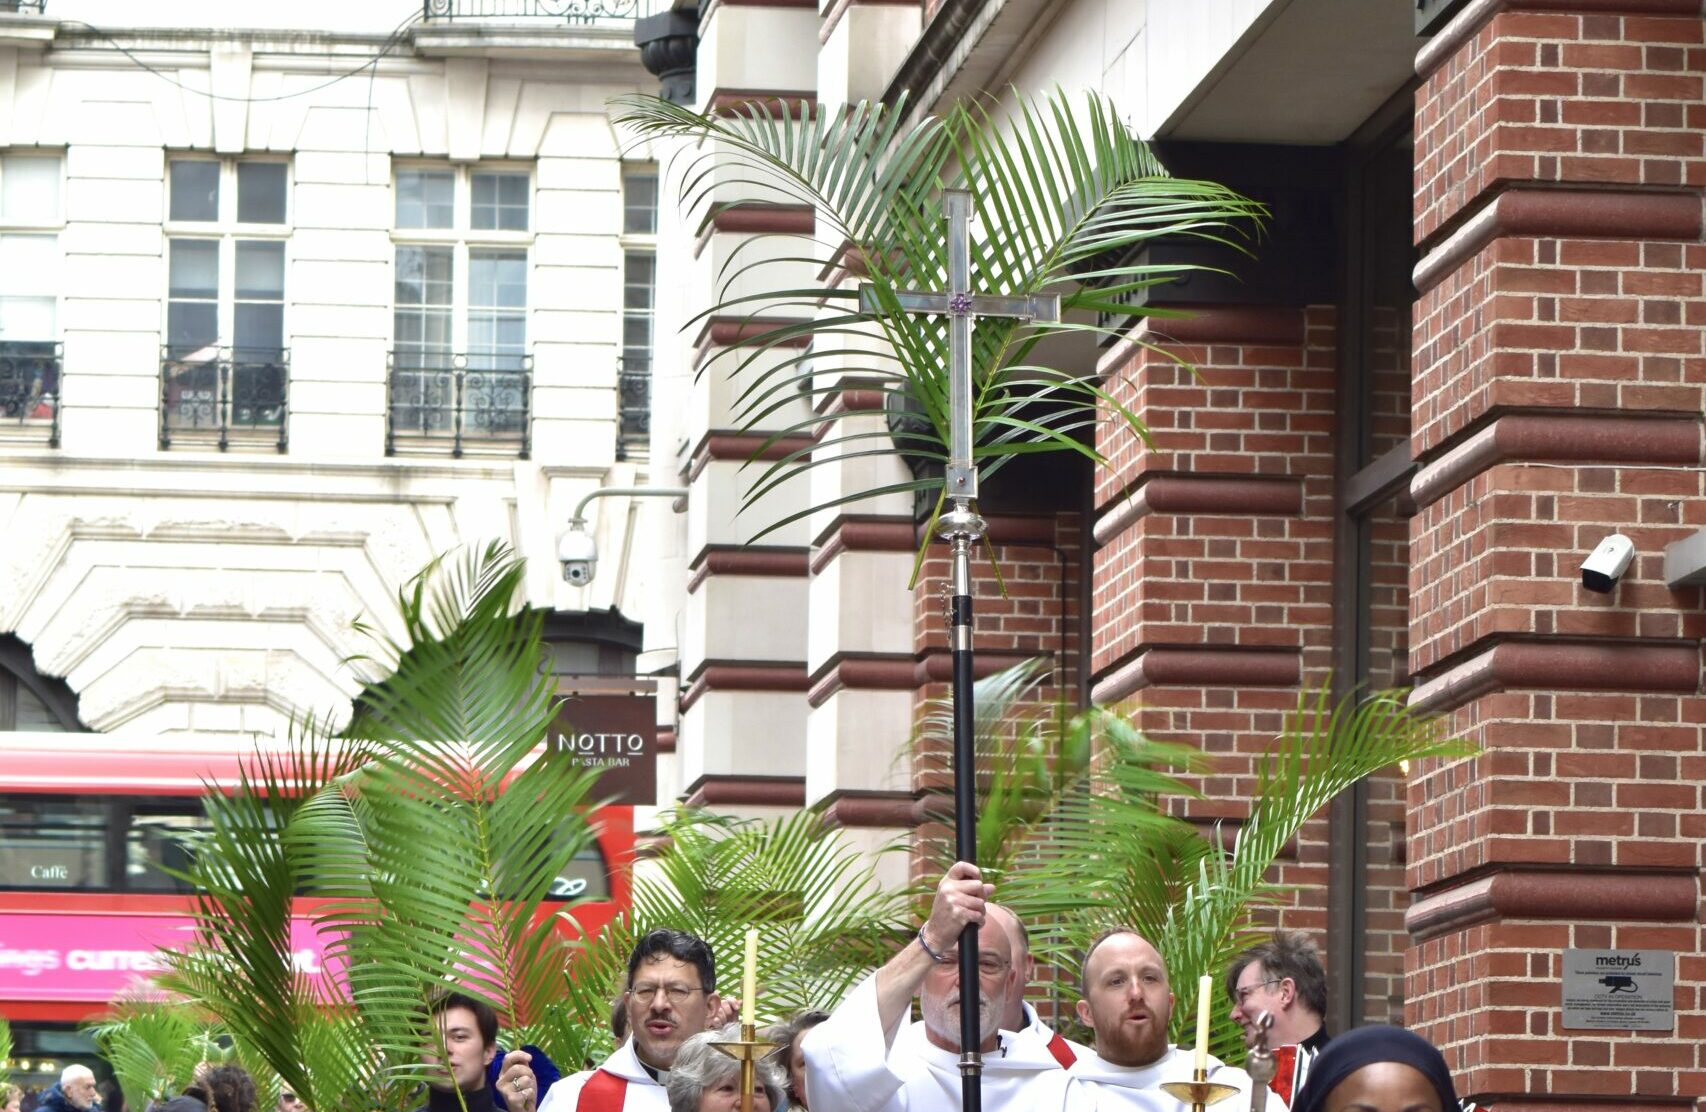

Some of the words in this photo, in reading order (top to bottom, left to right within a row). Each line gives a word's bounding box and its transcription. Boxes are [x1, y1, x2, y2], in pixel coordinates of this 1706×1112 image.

[558, 733, 643, 755] NOTTO
[607, 757, 630, 767] BAR
[1596, 953, 1641, 970] metrus
